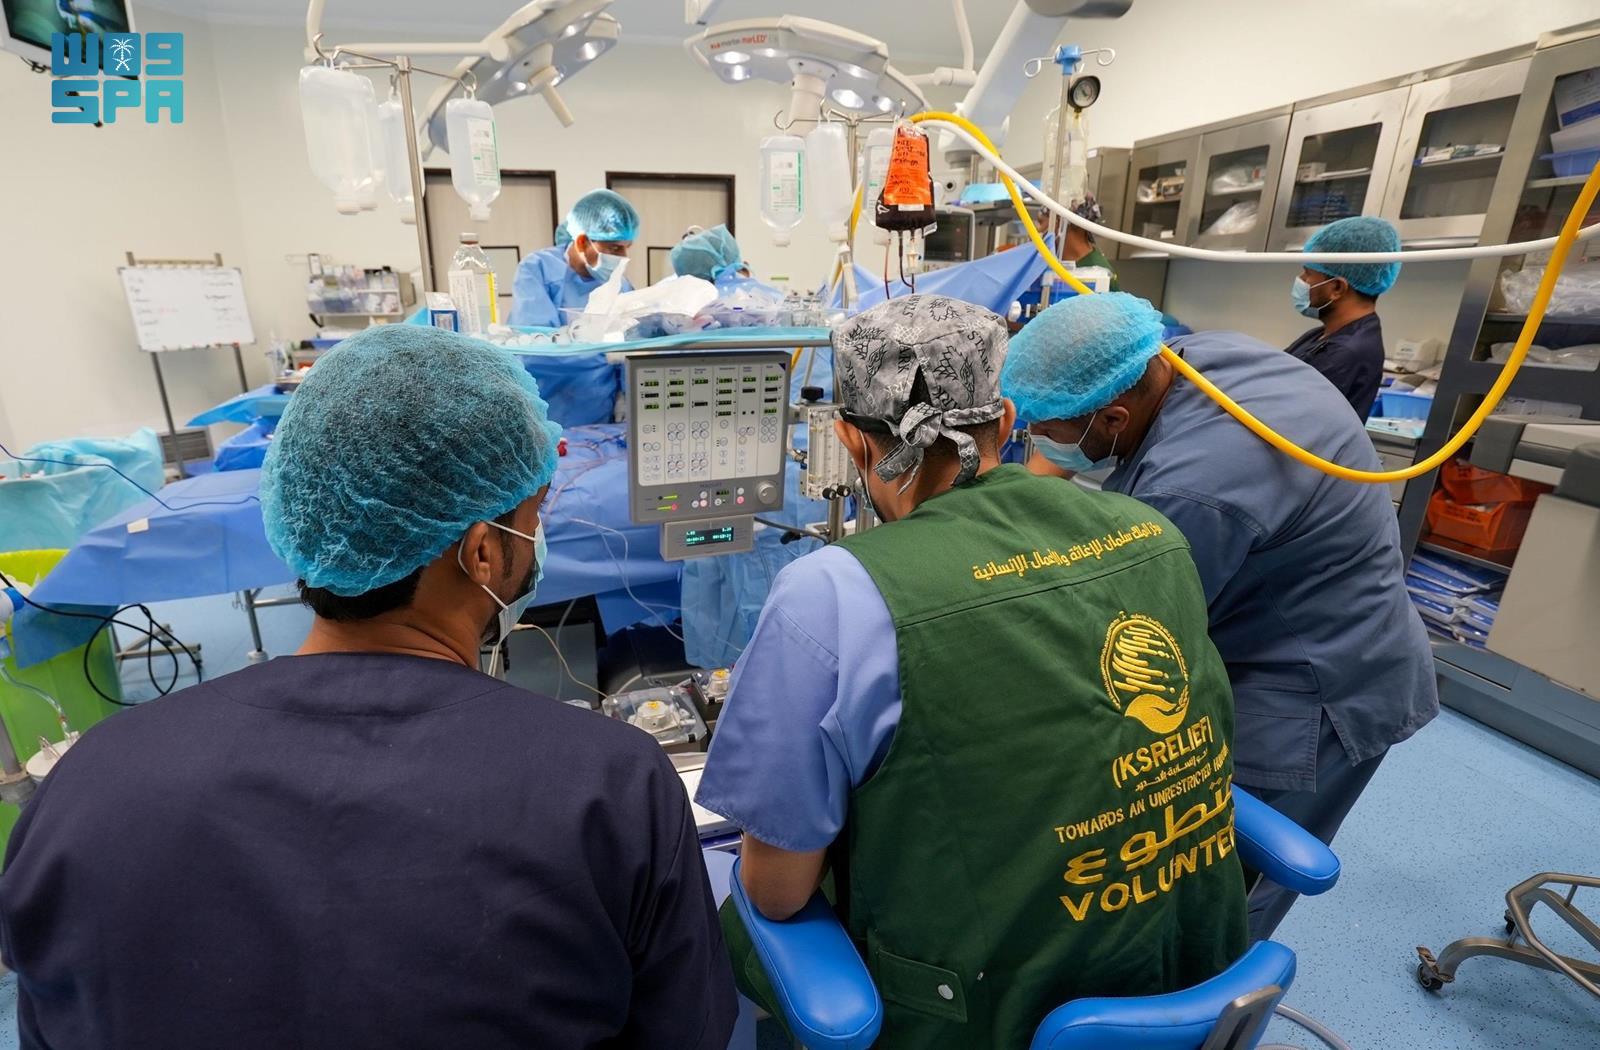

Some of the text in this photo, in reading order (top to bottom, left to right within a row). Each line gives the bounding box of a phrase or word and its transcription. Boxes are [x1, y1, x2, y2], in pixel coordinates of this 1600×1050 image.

[967, 330, 994, 378] STARK
[1103, 530, 1133, 551] سلمان
[972, 554, 1028, 581] الإنسانية
[1112, 716, 1213, 788] (KSRELIEF)
[1055, 808, 1125, 843] TOWARDS
[1129, 799, 1146, 818] AN
[1149, 762, 1211, 808] UNRESTRICTED
